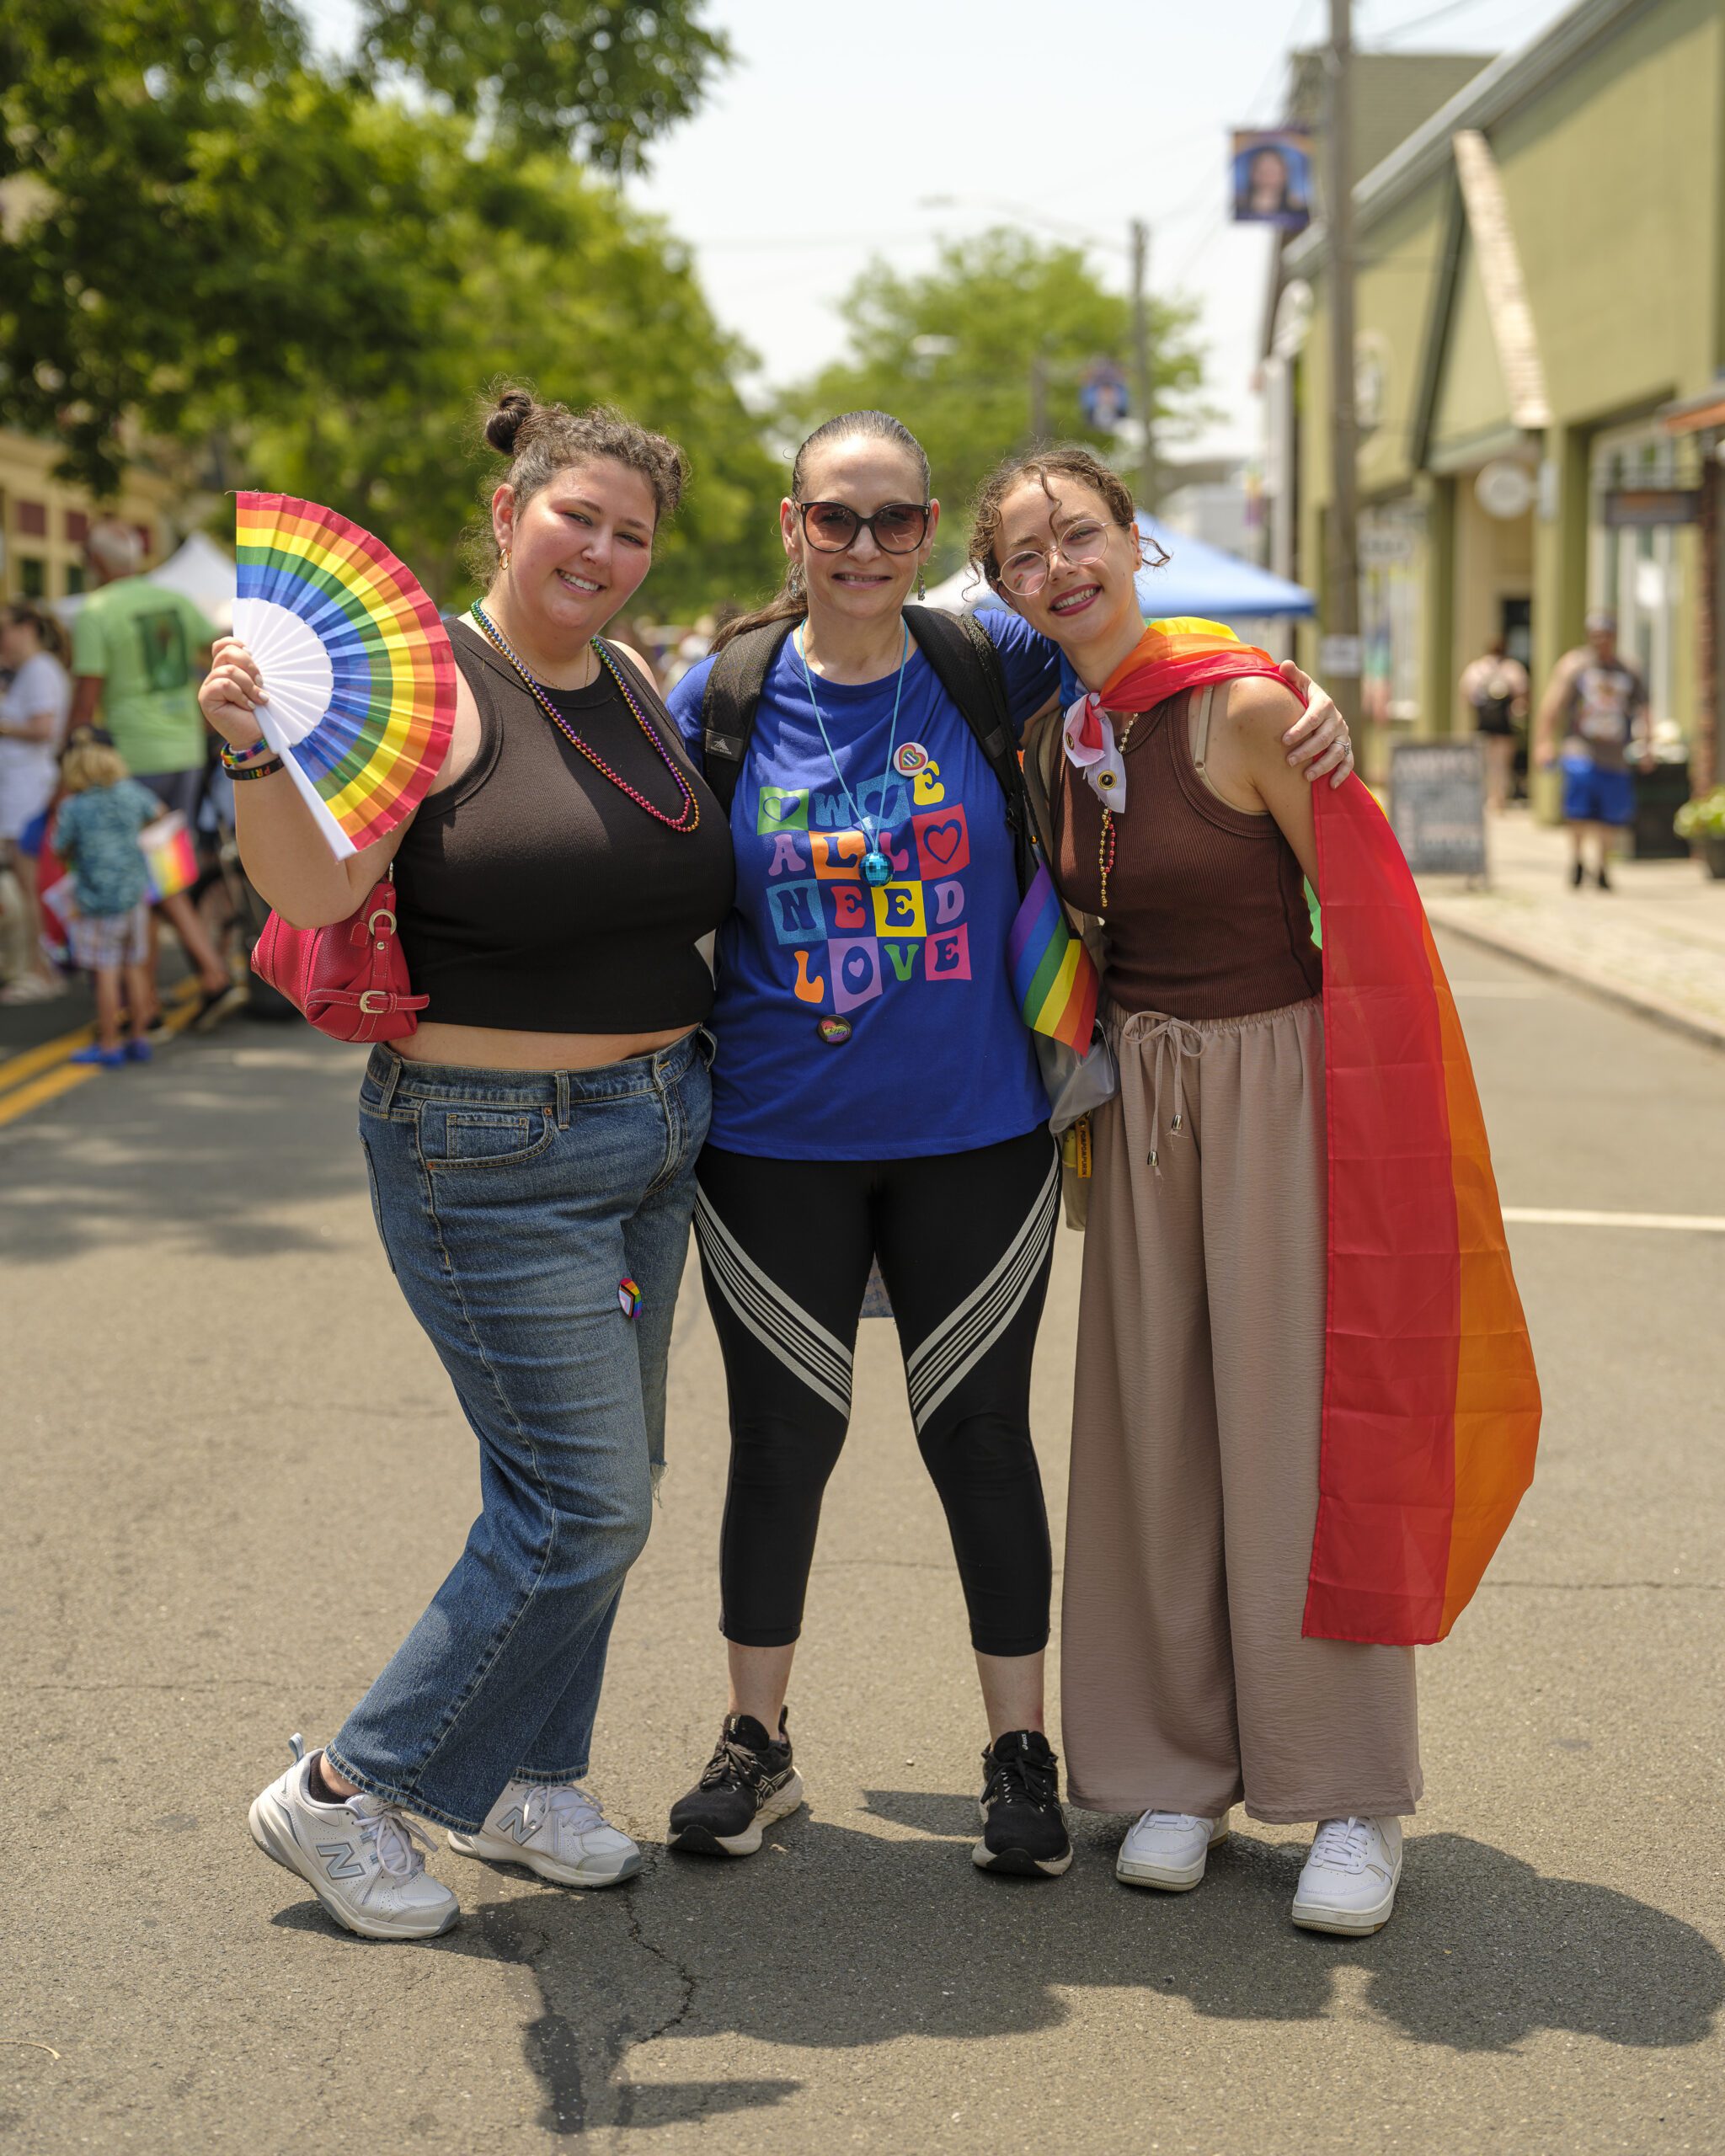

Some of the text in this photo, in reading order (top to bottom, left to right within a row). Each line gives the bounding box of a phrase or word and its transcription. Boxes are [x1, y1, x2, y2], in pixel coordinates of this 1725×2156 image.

[768, 831, 909, 876] ALL
[776, 880, 964, 931] NEED
[793, 936, 959, 1003] LOVE
